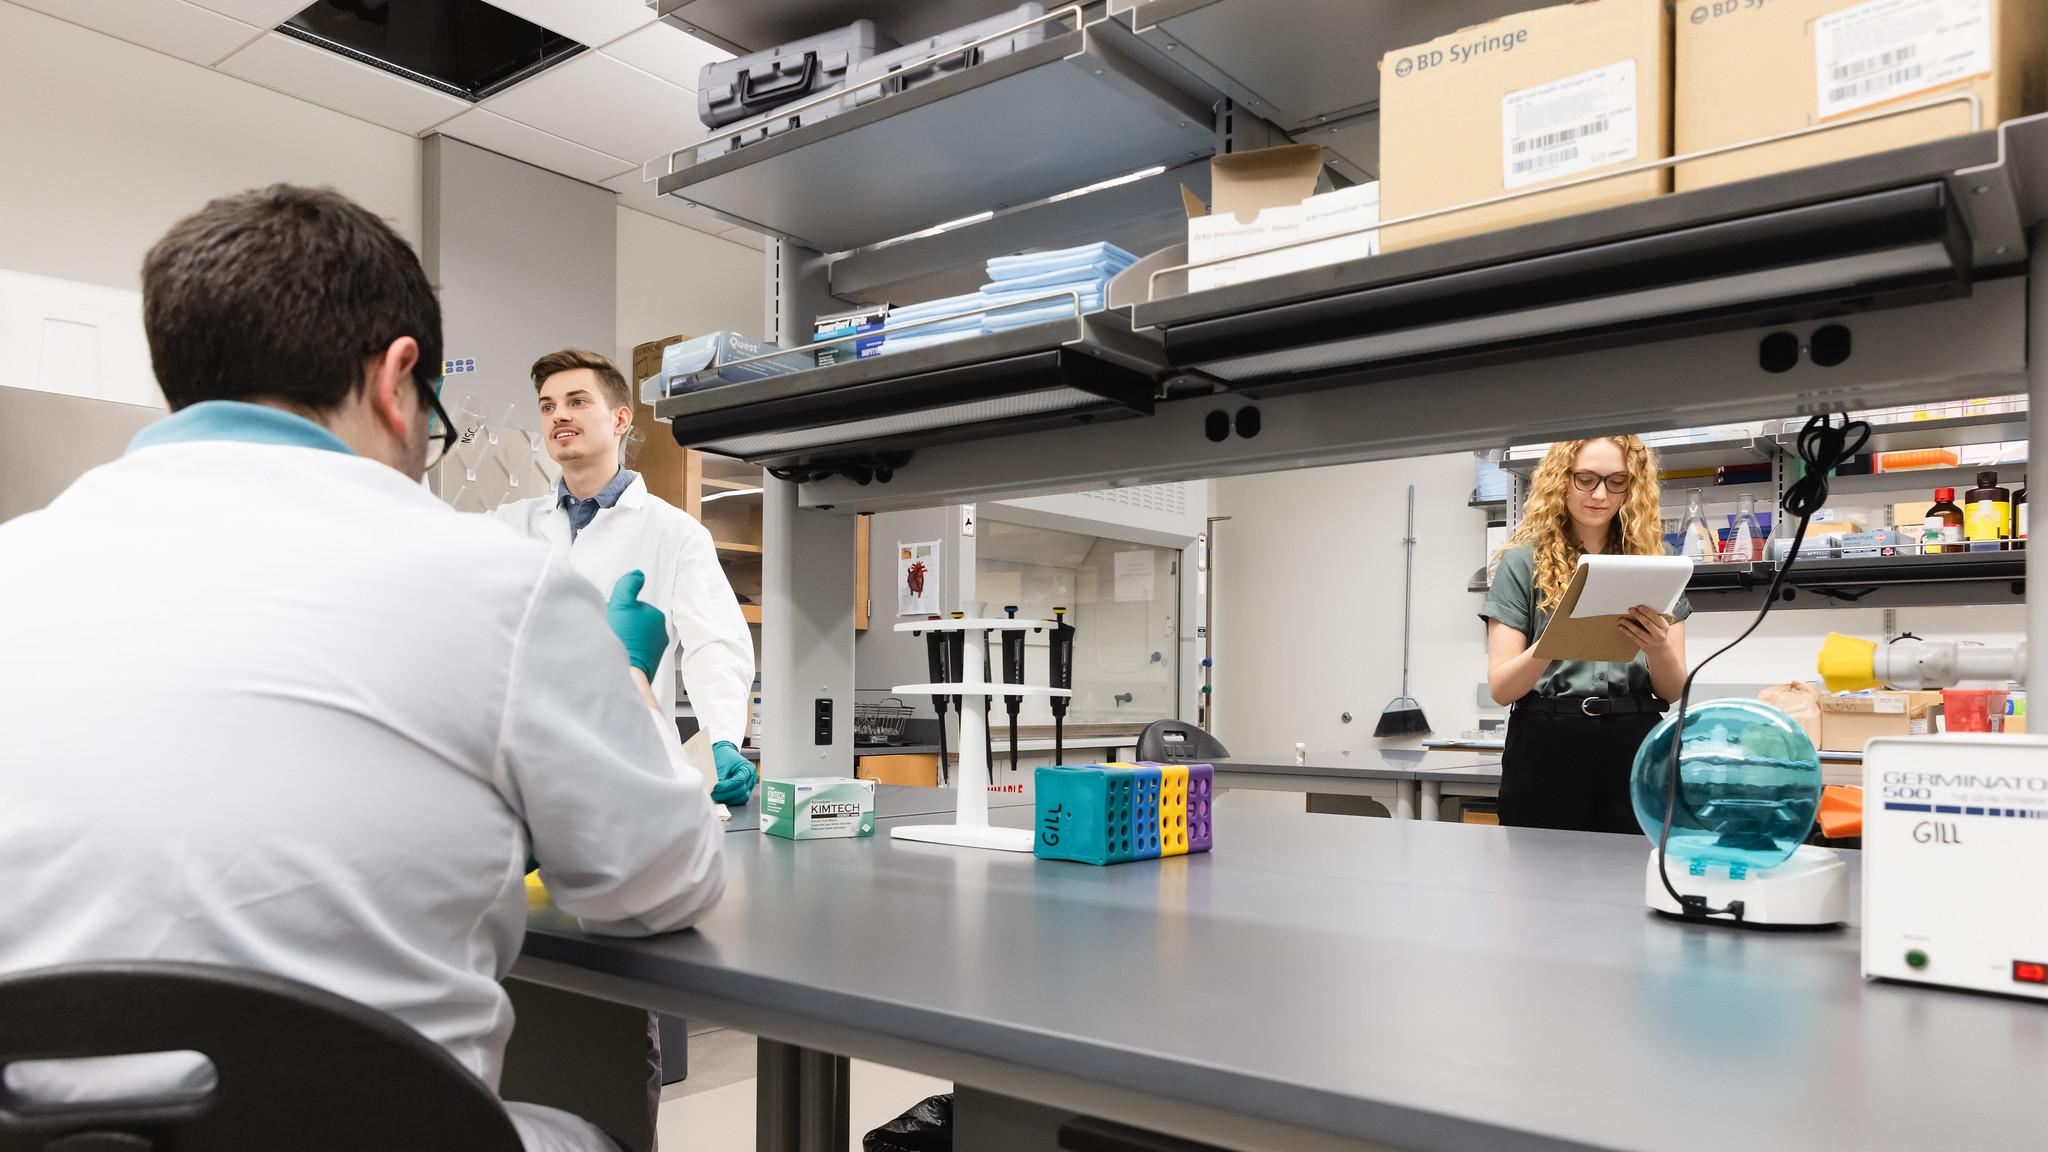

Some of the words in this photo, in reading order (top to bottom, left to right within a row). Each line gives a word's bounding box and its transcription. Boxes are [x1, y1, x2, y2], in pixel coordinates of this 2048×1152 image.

[1712, 0, 1739, 17] BD
[1416, 50, 1444, 71] BD
[1449, 28, 1528, 63] Syringe
[461, 427, 478, 444] NSC
[1883, 786, 1932, 800] 500
[811, 803, 860, 814] KIMTECH
[1042, 803, 1062, 847] GILL
[1912, 820, 1962, 844] GILL
